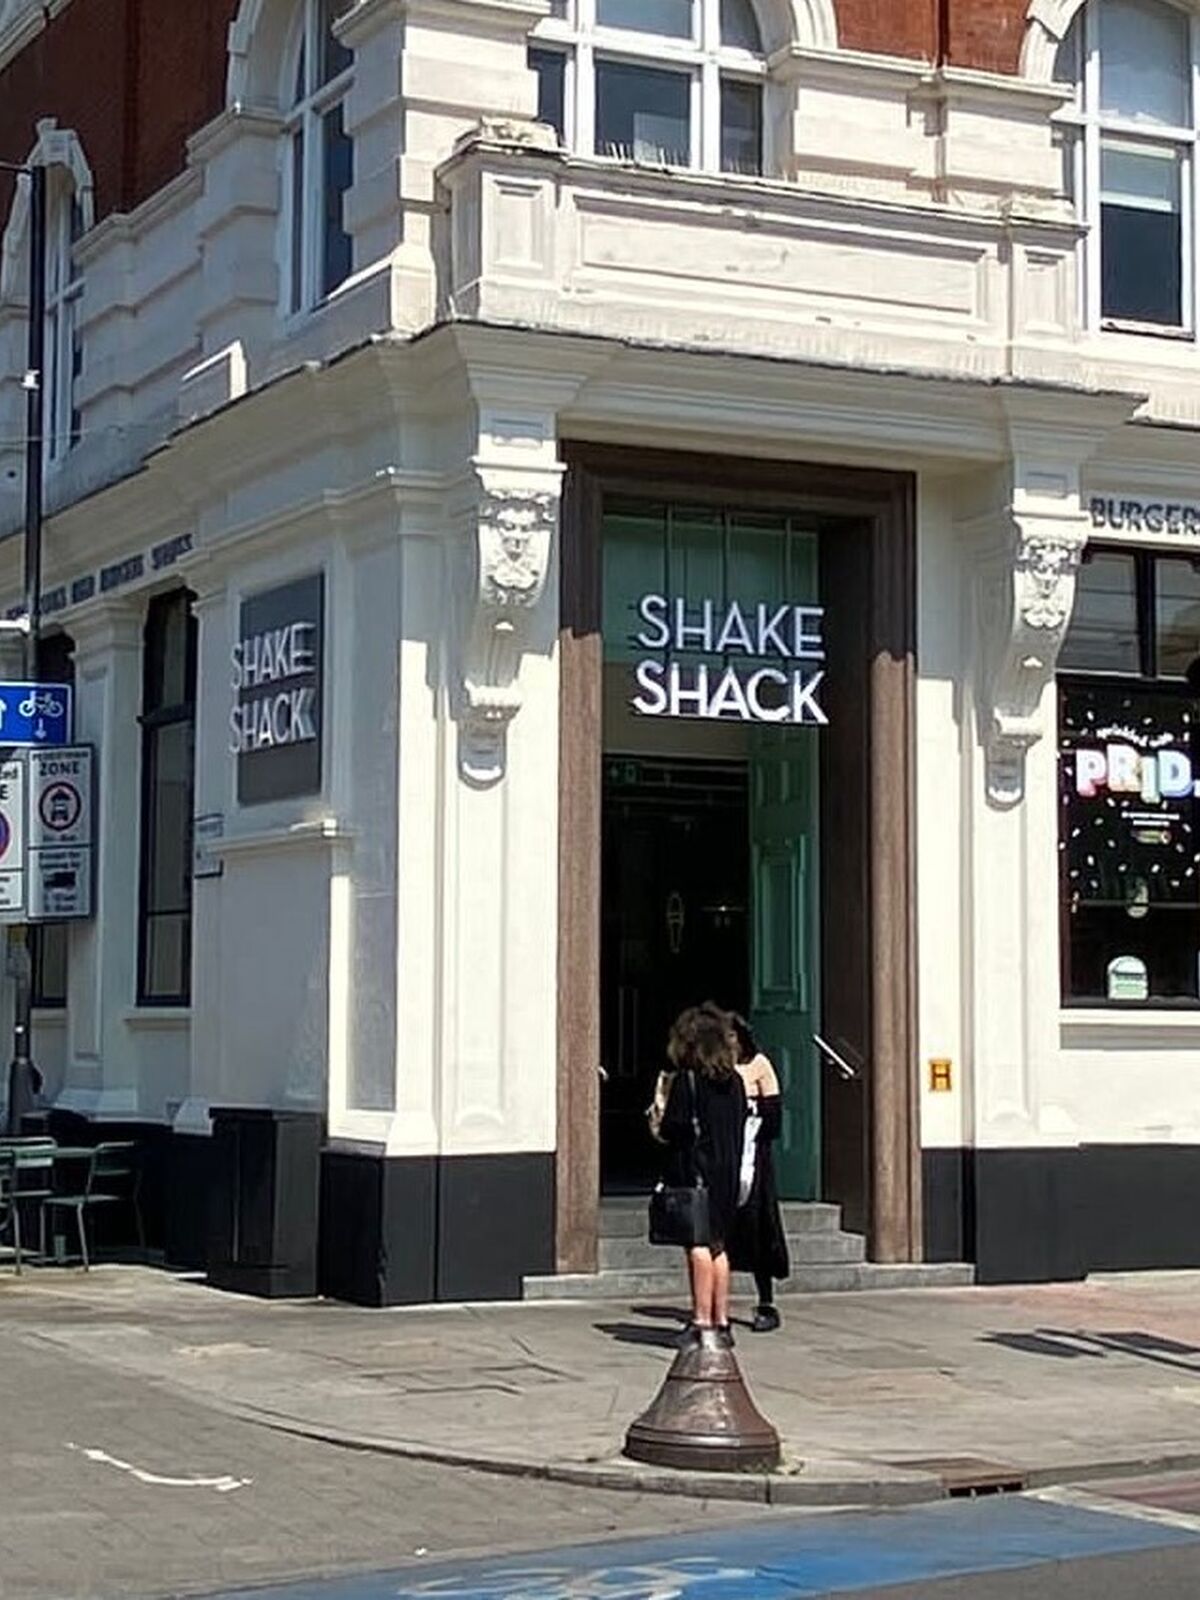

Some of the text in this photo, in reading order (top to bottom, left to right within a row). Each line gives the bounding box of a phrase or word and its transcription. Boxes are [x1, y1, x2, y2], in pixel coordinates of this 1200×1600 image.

[1090, 497, 1200, 536] BURGER
[231, 622, 315, 690] SHAKE
[637, 594, 825, 660] SHAKE
[228, 688, 316, 754] SHACK
[632, 659, 830, 724] SHACK
[39, 761, 80, 777] ZONE
[1076, 743, 1200, 804] PRID
